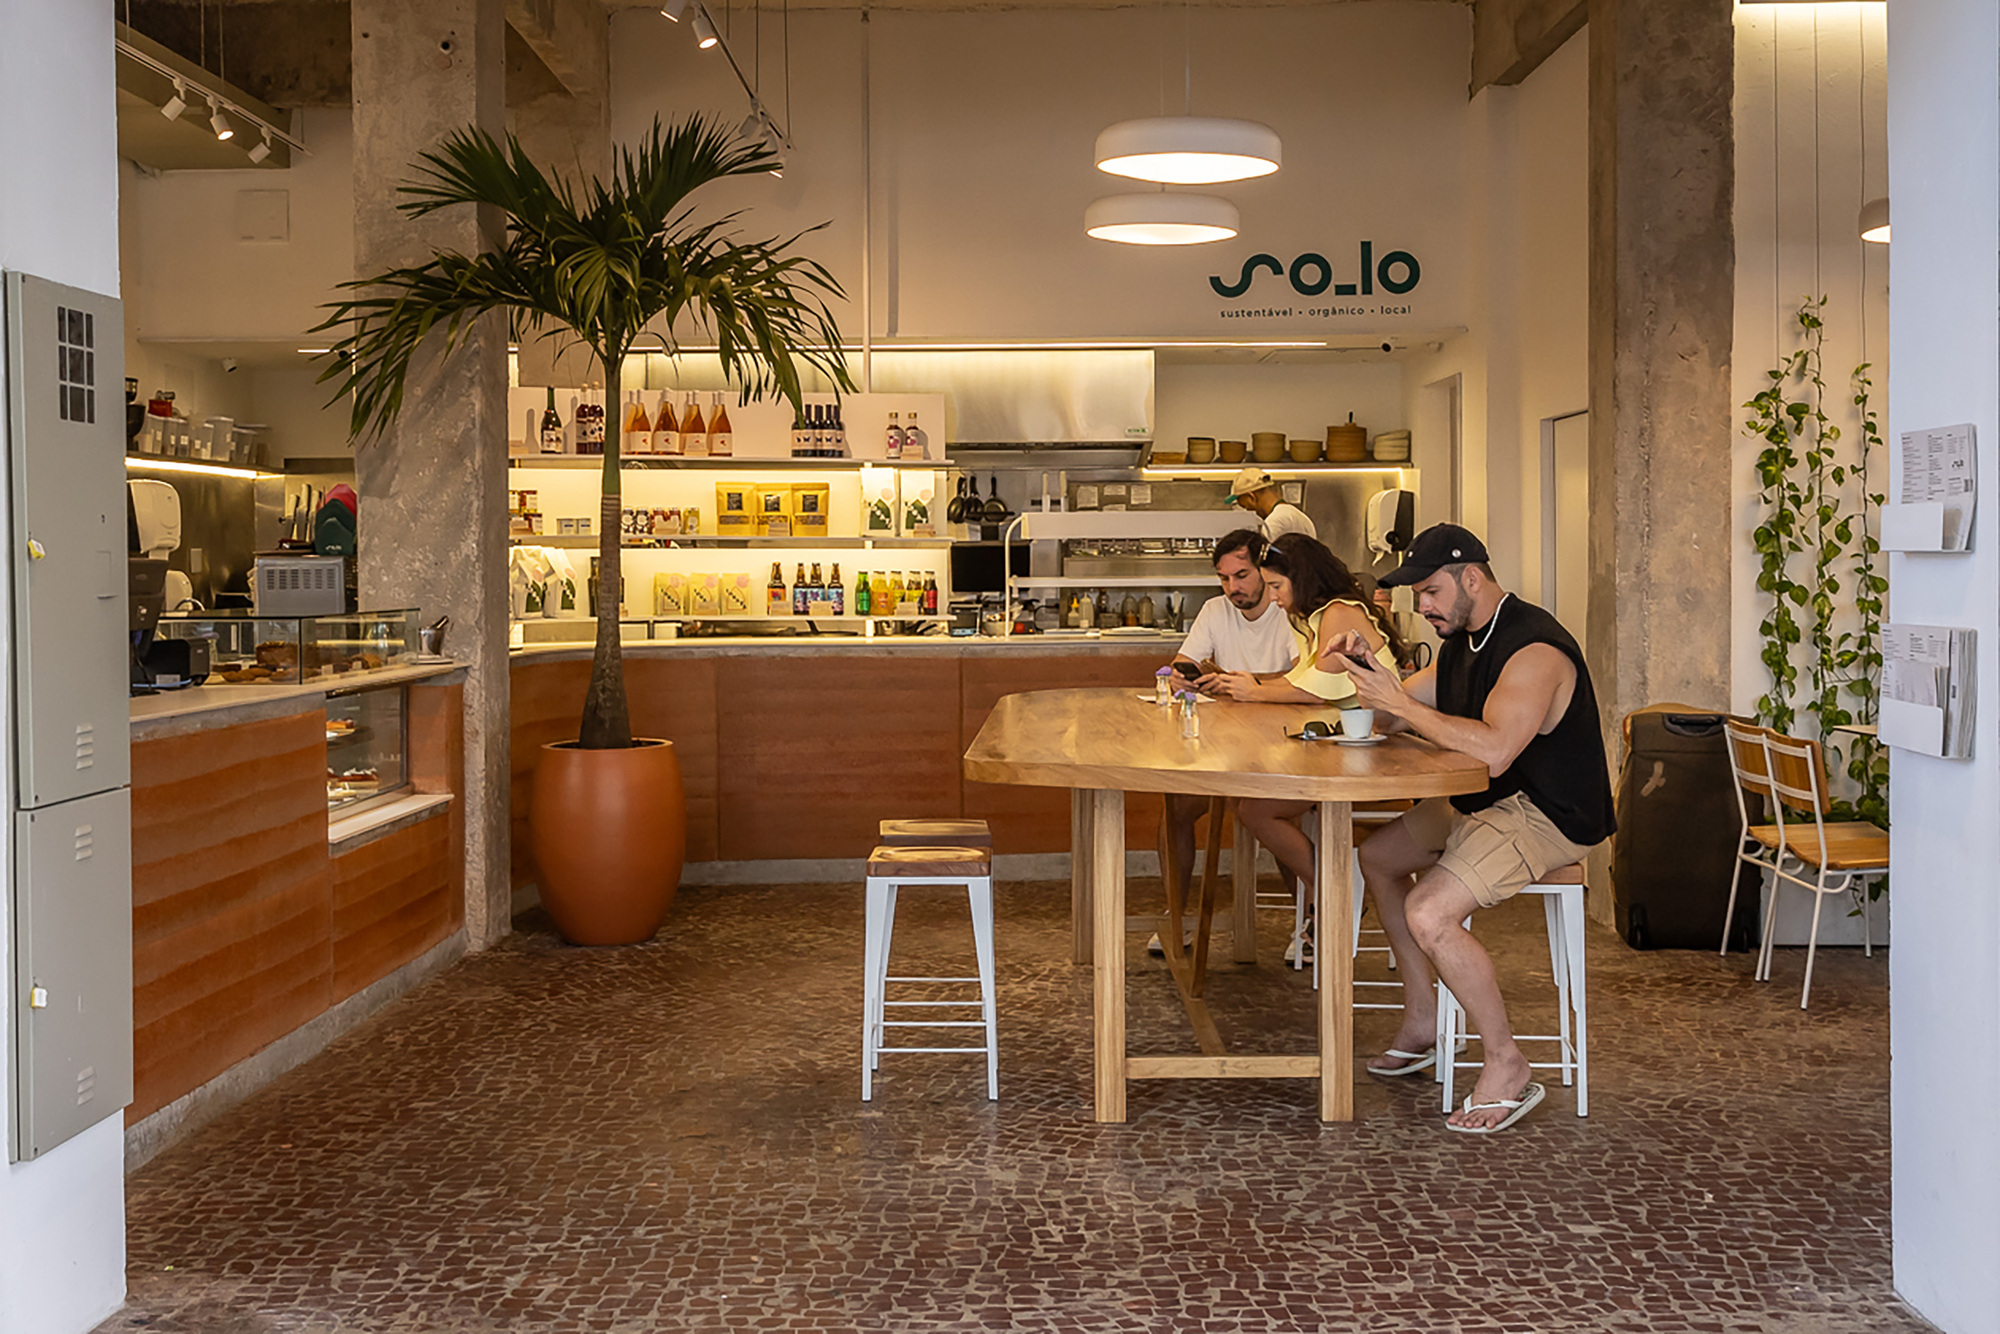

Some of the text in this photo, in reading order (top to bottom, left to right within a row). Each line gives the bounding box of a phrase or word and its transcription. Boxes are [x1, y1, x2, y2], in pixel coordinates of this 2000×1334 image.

[1220, 304, 1411, 318] sustentável orgânico local
